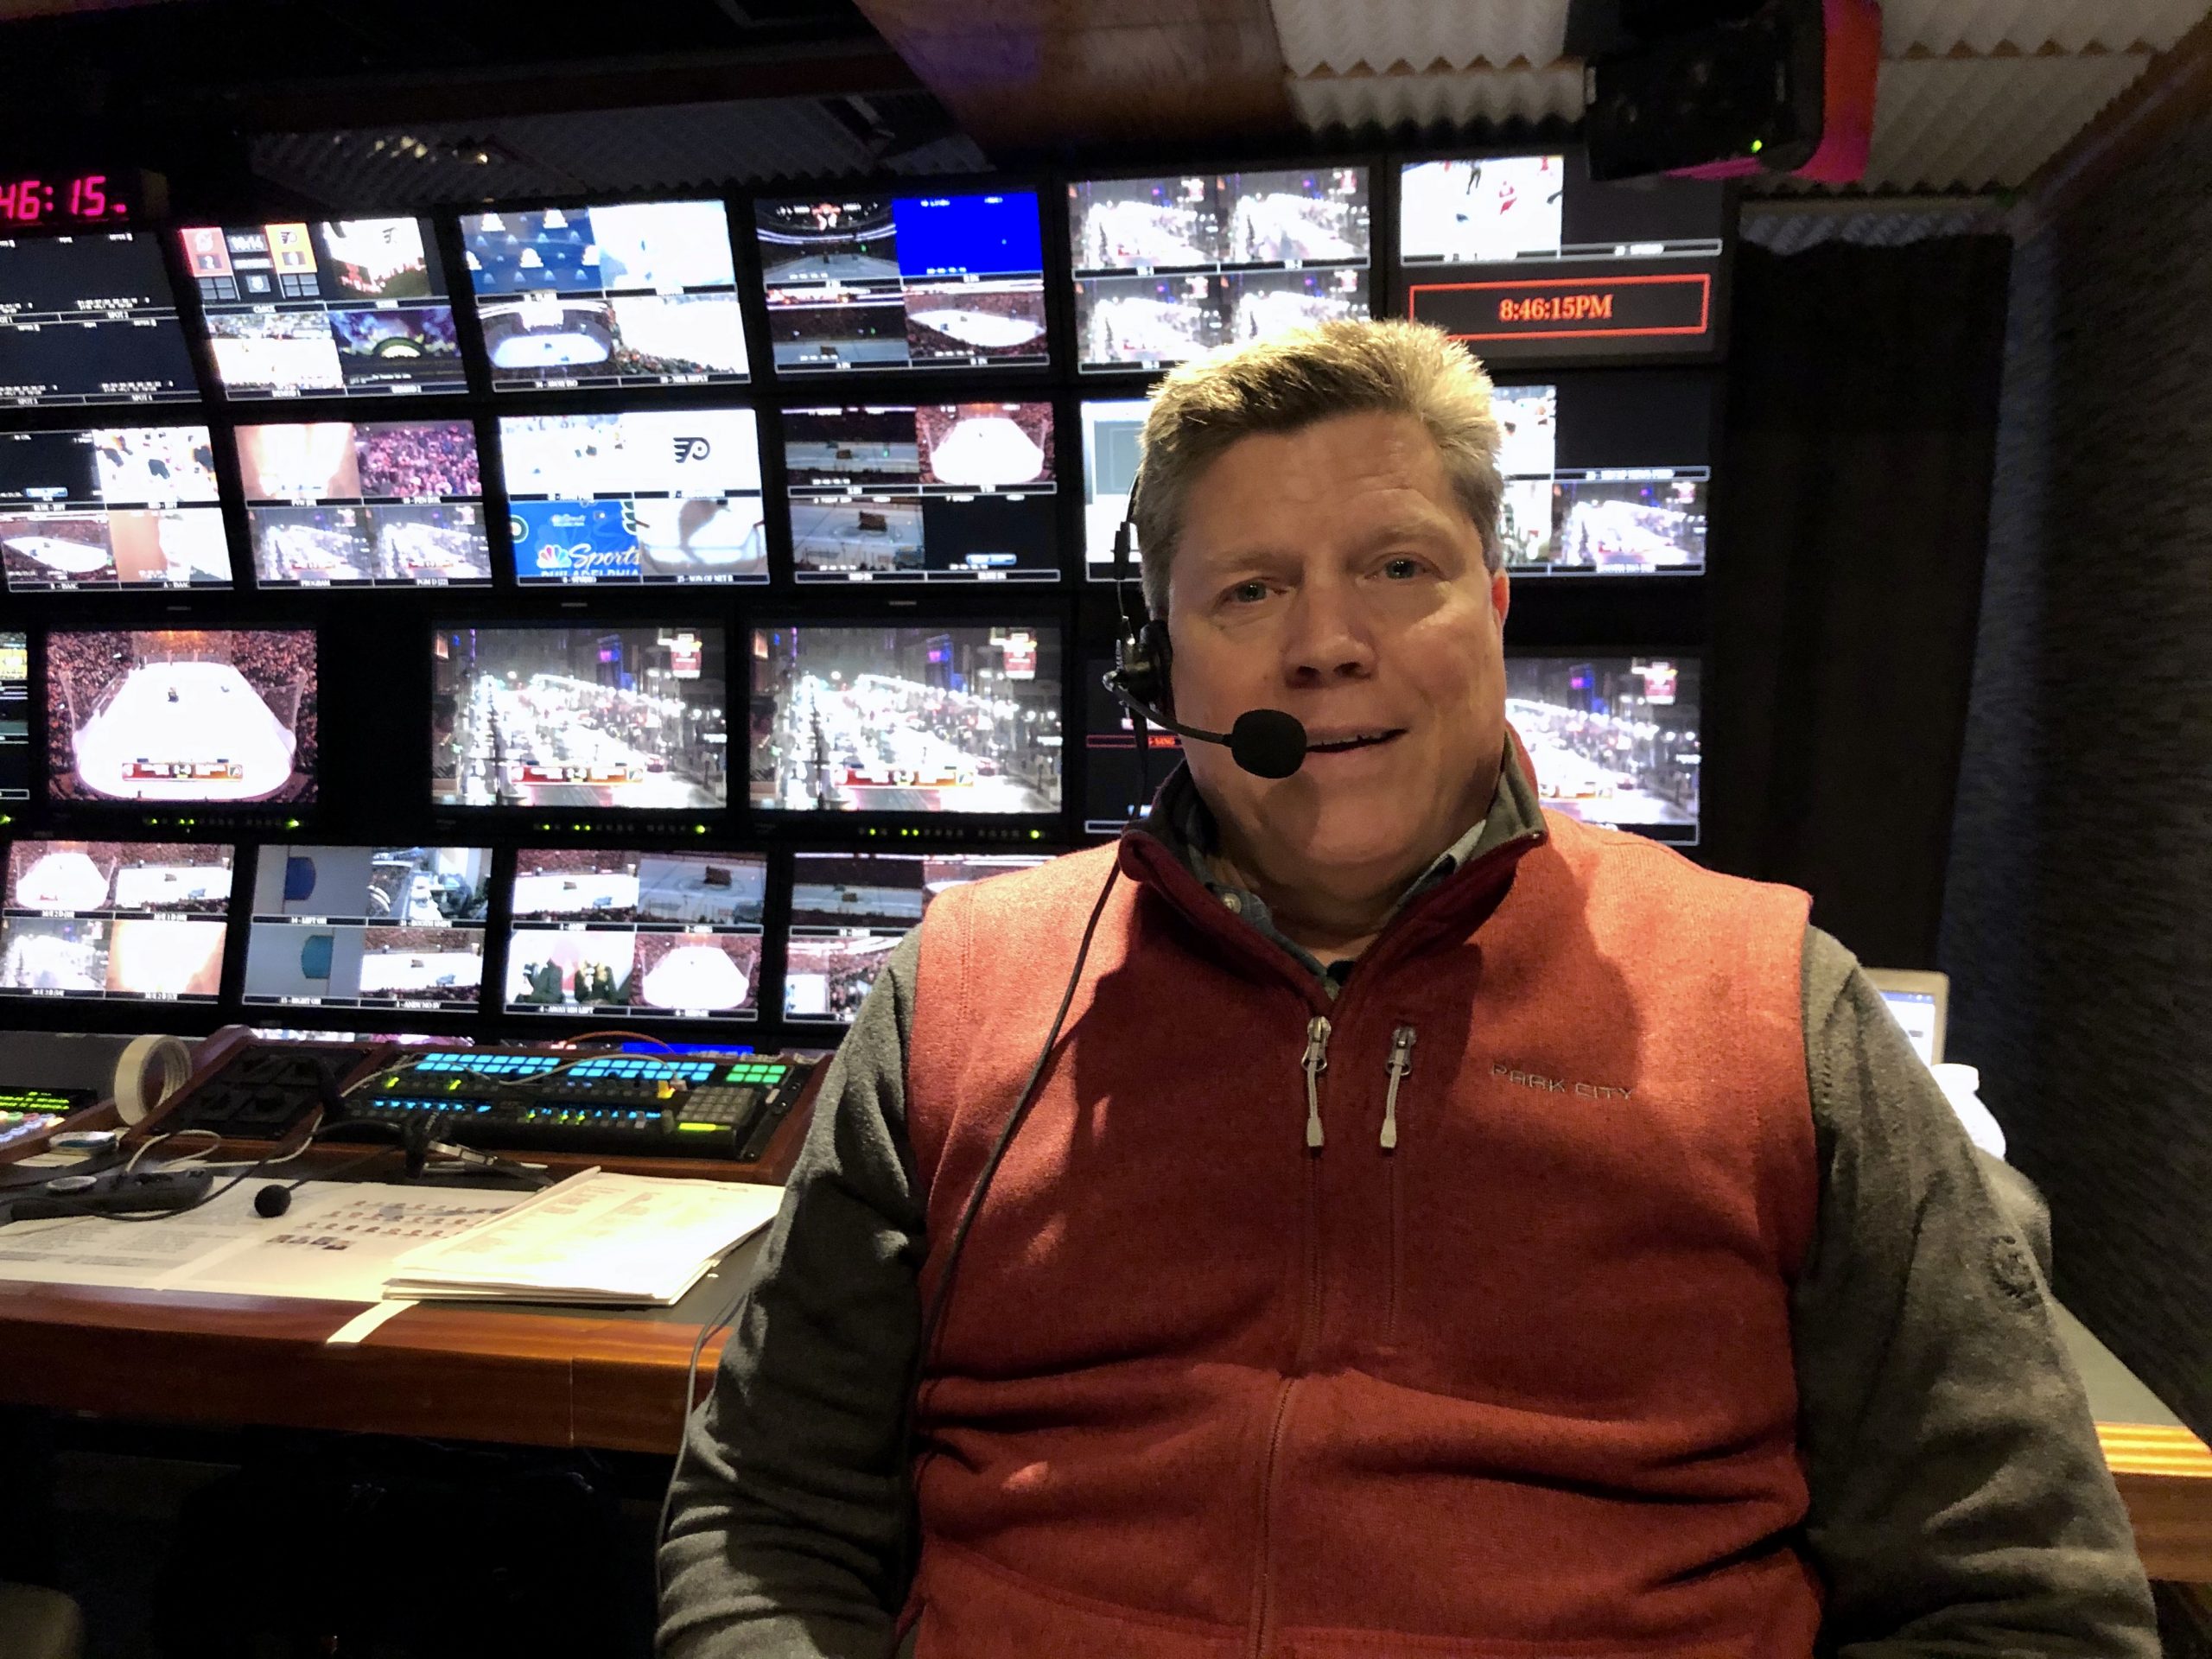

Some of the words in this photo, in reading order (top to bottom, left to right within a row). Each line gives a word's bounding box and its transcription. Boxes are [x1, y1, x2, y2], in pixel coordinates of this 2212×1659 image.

[1498, 294, 1614, 322] 8:46:15PM
[569, 543, 641, 570] Sports
[1491, 1063, 1566, 1093] PARK
[1575, 1082, 1633, 1100] CITY
